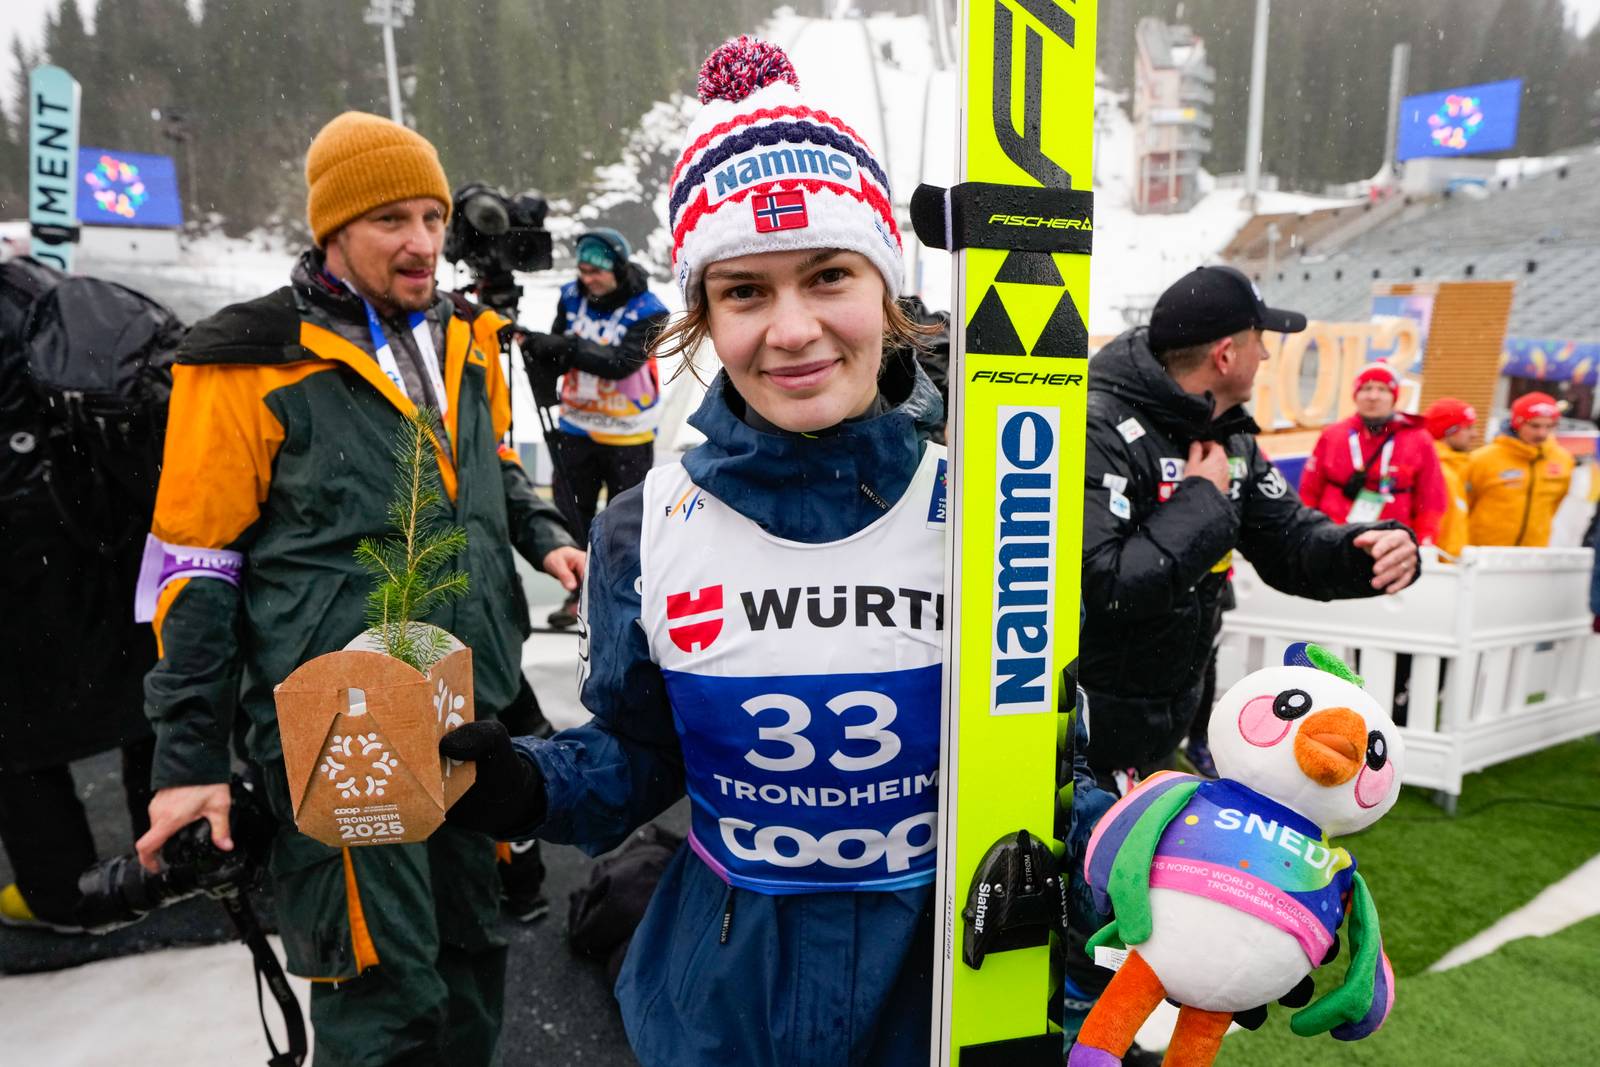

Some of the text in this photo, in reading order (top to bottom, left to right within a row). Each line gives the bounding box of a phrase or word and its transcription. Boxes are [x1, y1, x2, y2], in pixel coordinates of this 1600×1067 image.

[714, 149, 852, 197] Nammo
[988, 214, 1082, 230] FISCHER
[971, 370, 1084, 386] FISCHER
[995, 411, 1054, 711] Nammo
[740, 690, 902, 772] 33
[713, 770, 940, 807] TRONDHEIM
[336, 813, 400, 824] TRONDHEIM
[339, 821, 405, 839] 2025
[718, 811, 938, 873] coop
[1167, 863, 1209, 876] NORDIC
[1212, 871, 1254, 890] WORLD
[1257, 887, 1276, 901] SKI
[1207, 880, 1274, 911] TRONDHEIM
[974, 882, 991, 934] Slatnar
